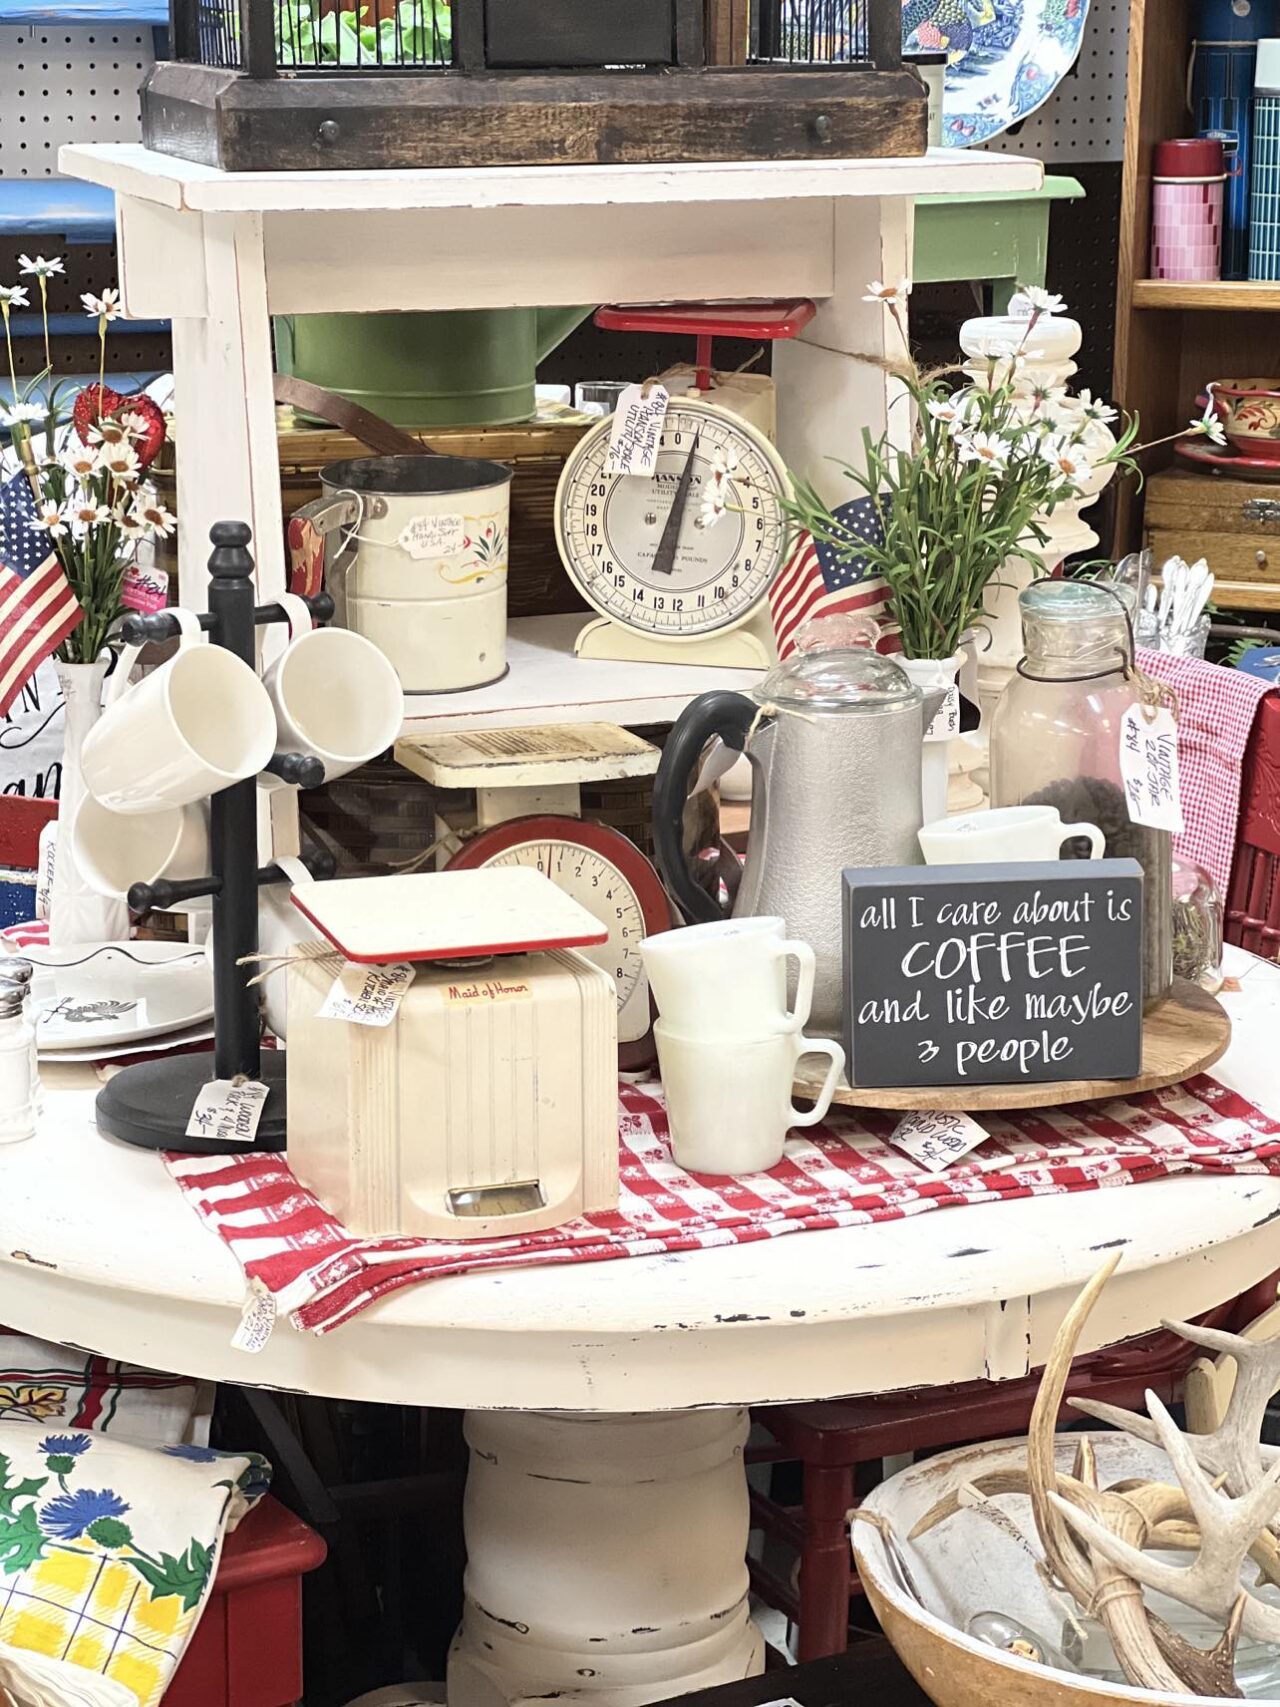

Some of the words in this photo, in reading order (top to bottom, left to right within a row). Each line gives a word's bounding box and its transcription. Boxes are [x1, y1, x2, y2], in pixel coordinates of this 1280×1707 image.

[674, 432, 682, 444] 0
[591, 484, 606, 497] 20
[752, 497, 759, 509] 5
[586, 504, 597, 516] 19
[586, 524, 598, 536] 18
[756, 518, 763, 530] 6
[592, 544, 602, 558] 17
[755, 540, 762, 552] 7
[602, 562, 613, 574] 16
[744, 559, 751, 571] 8
[614, 575, 625, 588] 15
[732, 575, 738, 588] 9
[632, 588, 644, 601] 14
[714, 586, 724, 598] 10
[654, 598, 664, 610] 13
[672, 598, 684, 612] 12
[698, 596, 705, 608] 11
[1126, 718, 1140, 752] #84
[1157, 734, 1176, 802] VINTAGE
[537, 861, 544, 872] 0
[557, 862, 562, 872] 1
[575, 866, 582, 877] 2
[592, 876, 598, 887] 3
[606, 890, 612, 900] 4
[616, 908, 623, 919] 5
[860, 898, 896, 930] all
[908, 896, 924, 928] I
[936, 900, 1002, 926] care
[1012, 890, 1095, 925] about
[1107, 890, 1132, 922] is
[622, 927, 628, 938] 6
[622, 948, 629, 960] 7
[901, 932, 1090, 983] COFFEE
[616, 968, 624, 978] 8
[448, 984, 480, 1000] Maid
[482, 982, 495, 1000] of
[493, 982, 528, 994] Honor
[858, 990, 930, 1024] and
[946, 984, 1010, 1024] like
[1025, 982, 1134, 1026] maybe
[918, 1040, 940, 1064] 3
[956, 1030, 1074, 1076] people
